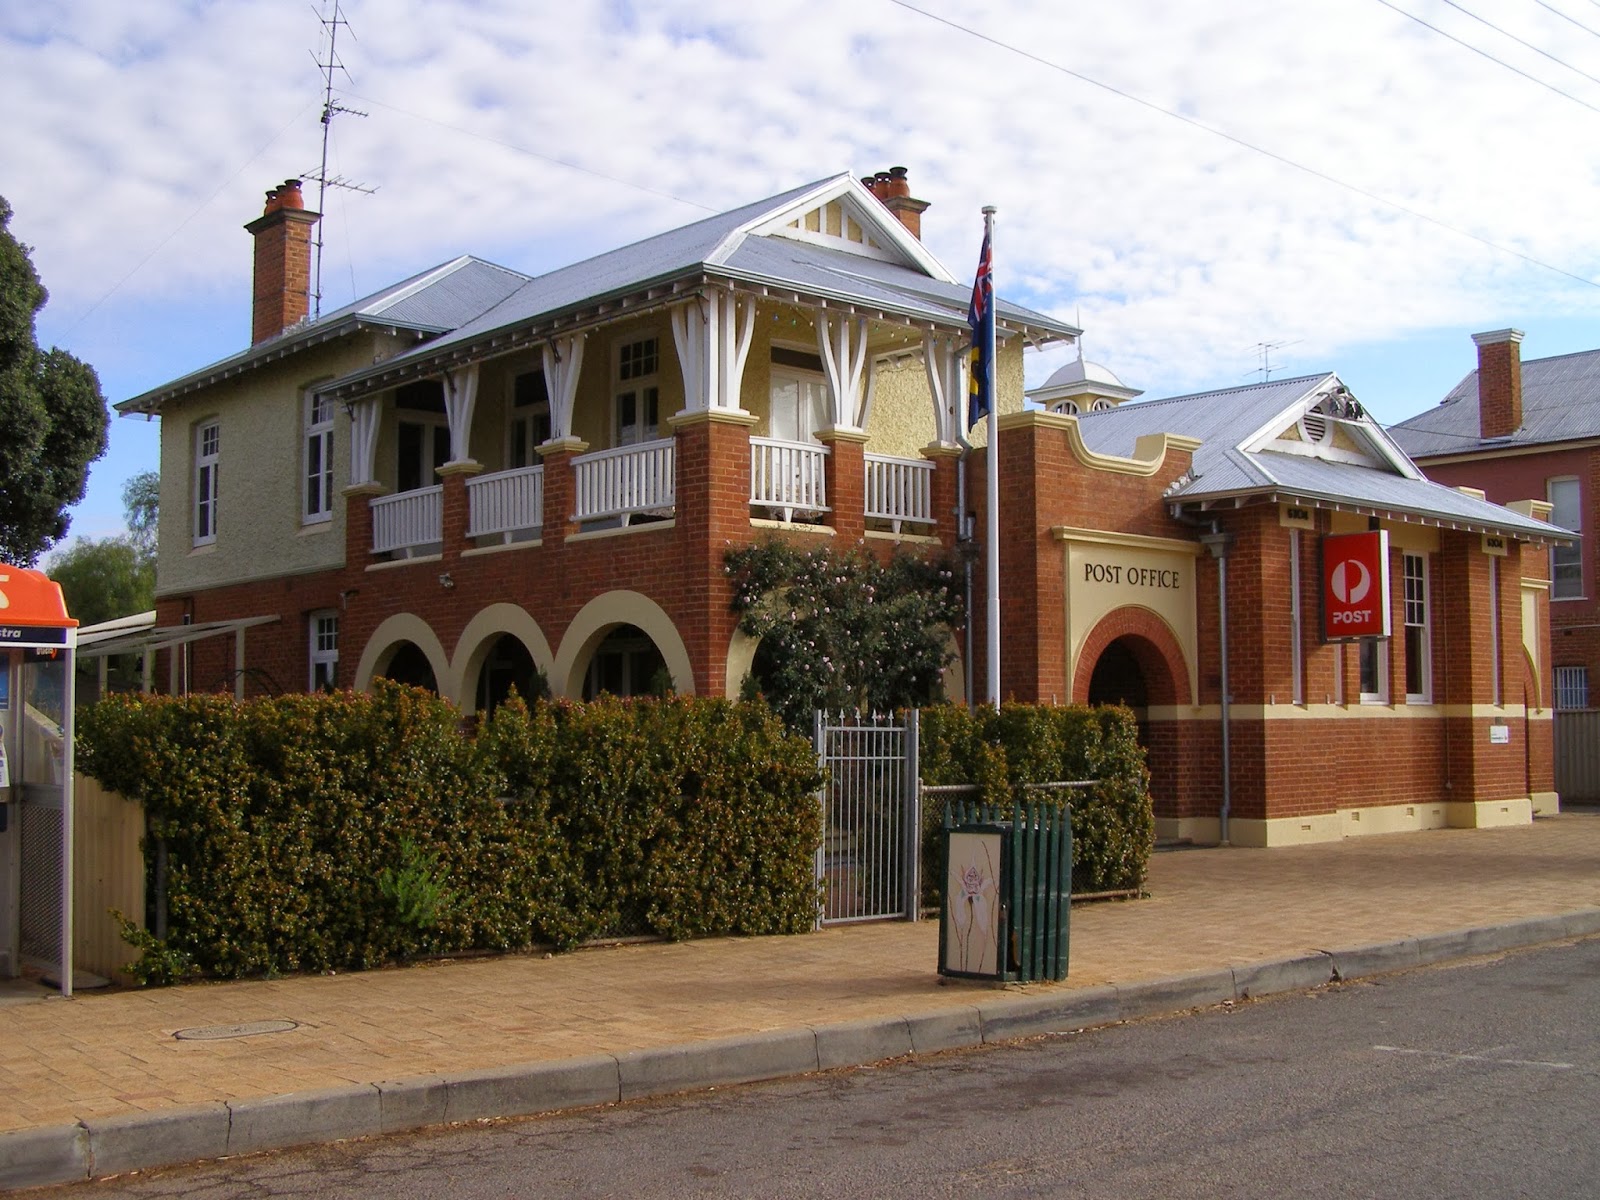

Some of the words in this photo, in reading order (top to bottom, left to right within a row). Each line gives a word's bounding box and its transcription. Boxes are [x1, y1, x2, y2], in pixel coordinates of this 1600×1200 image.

[1084, 563, 1122, 584] POST
[1127, 567, 1180, 589] OFFICE
[1333, 610, 1371, 624] POST
